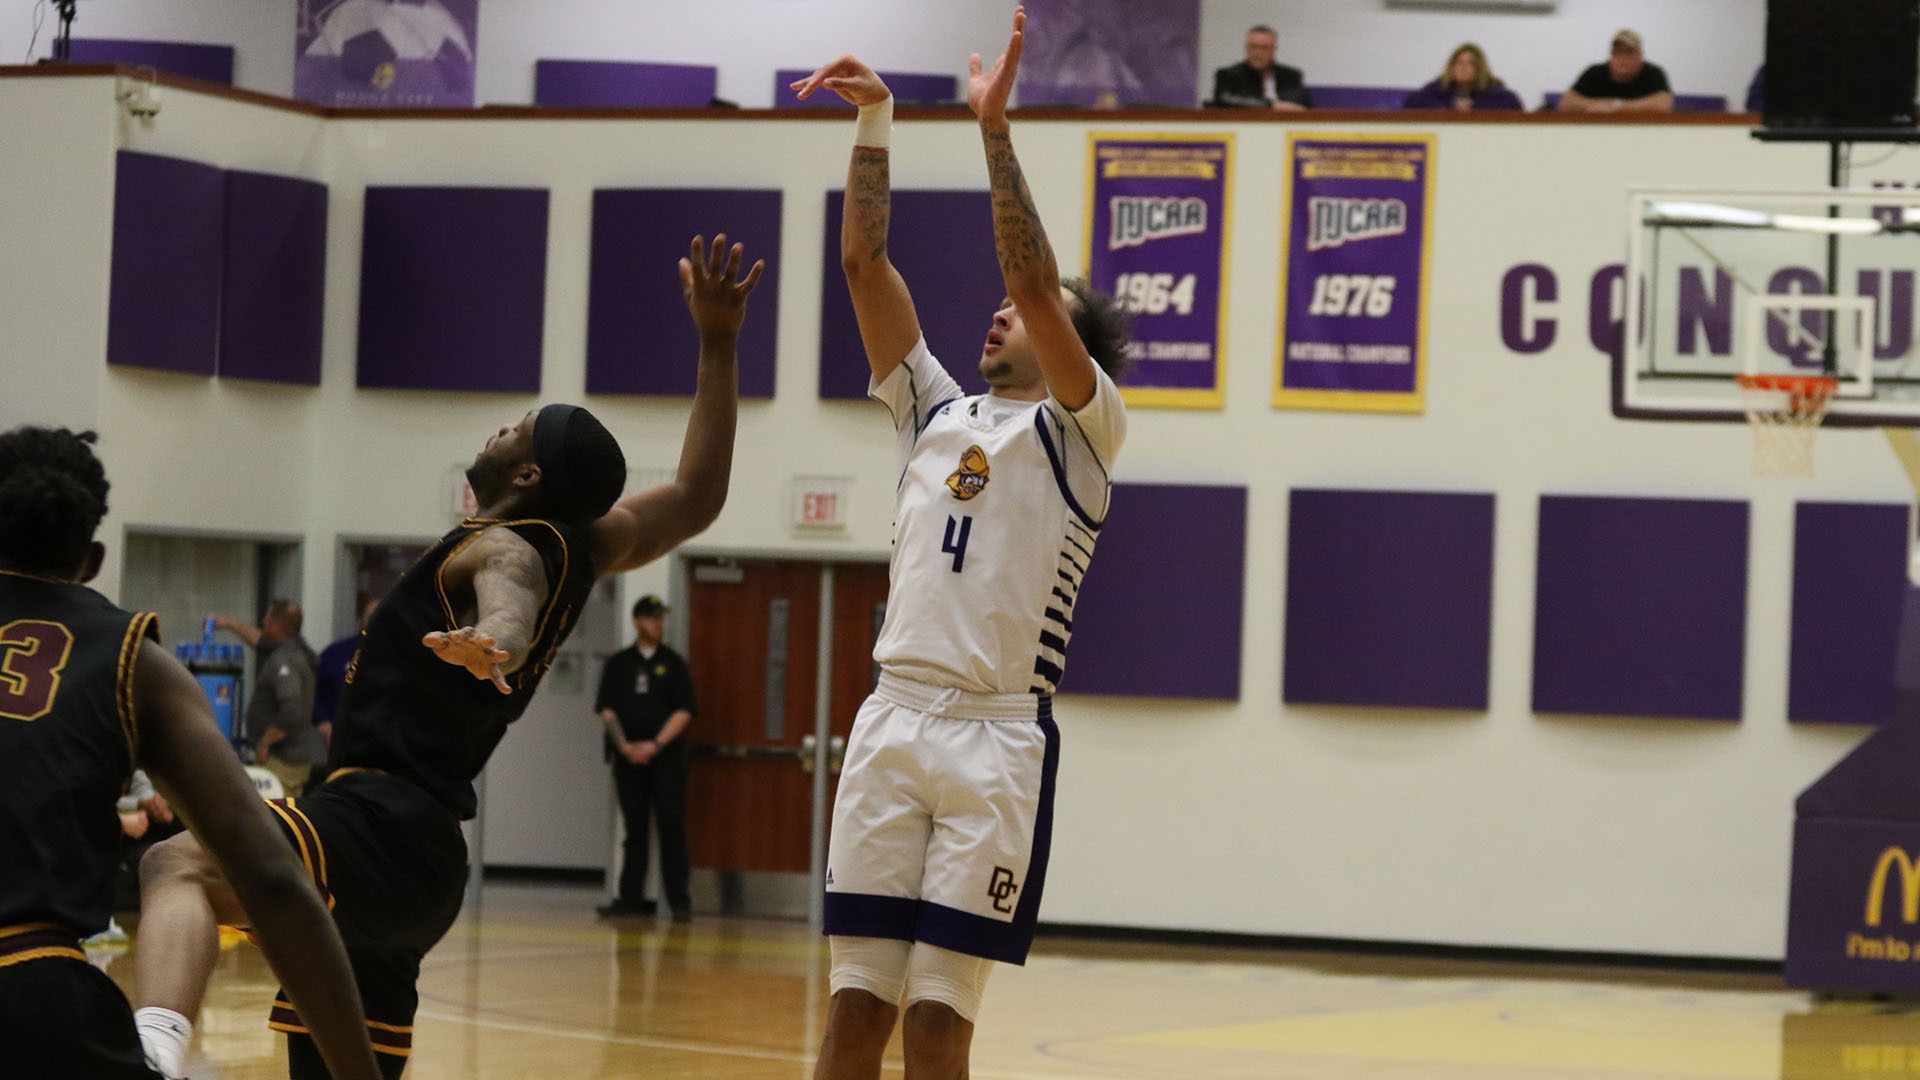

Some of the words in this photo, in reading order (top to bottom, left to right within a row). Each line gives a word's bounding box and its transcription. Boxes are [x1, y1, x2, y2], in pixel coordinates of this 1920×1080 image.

[1111, 197, 1206, 248] NJCAA
[1308, 197, 1406, 249] NJCAA
[1114, 273, 1197, 315] 1964
[1308, 274, 1396, 317] 1976
[804, 494, 838, 522] EXIT
[942, 513, 973, 573] 4
[0, 619, 74, 721] 3
[988, 865, 1018, 914] DC
